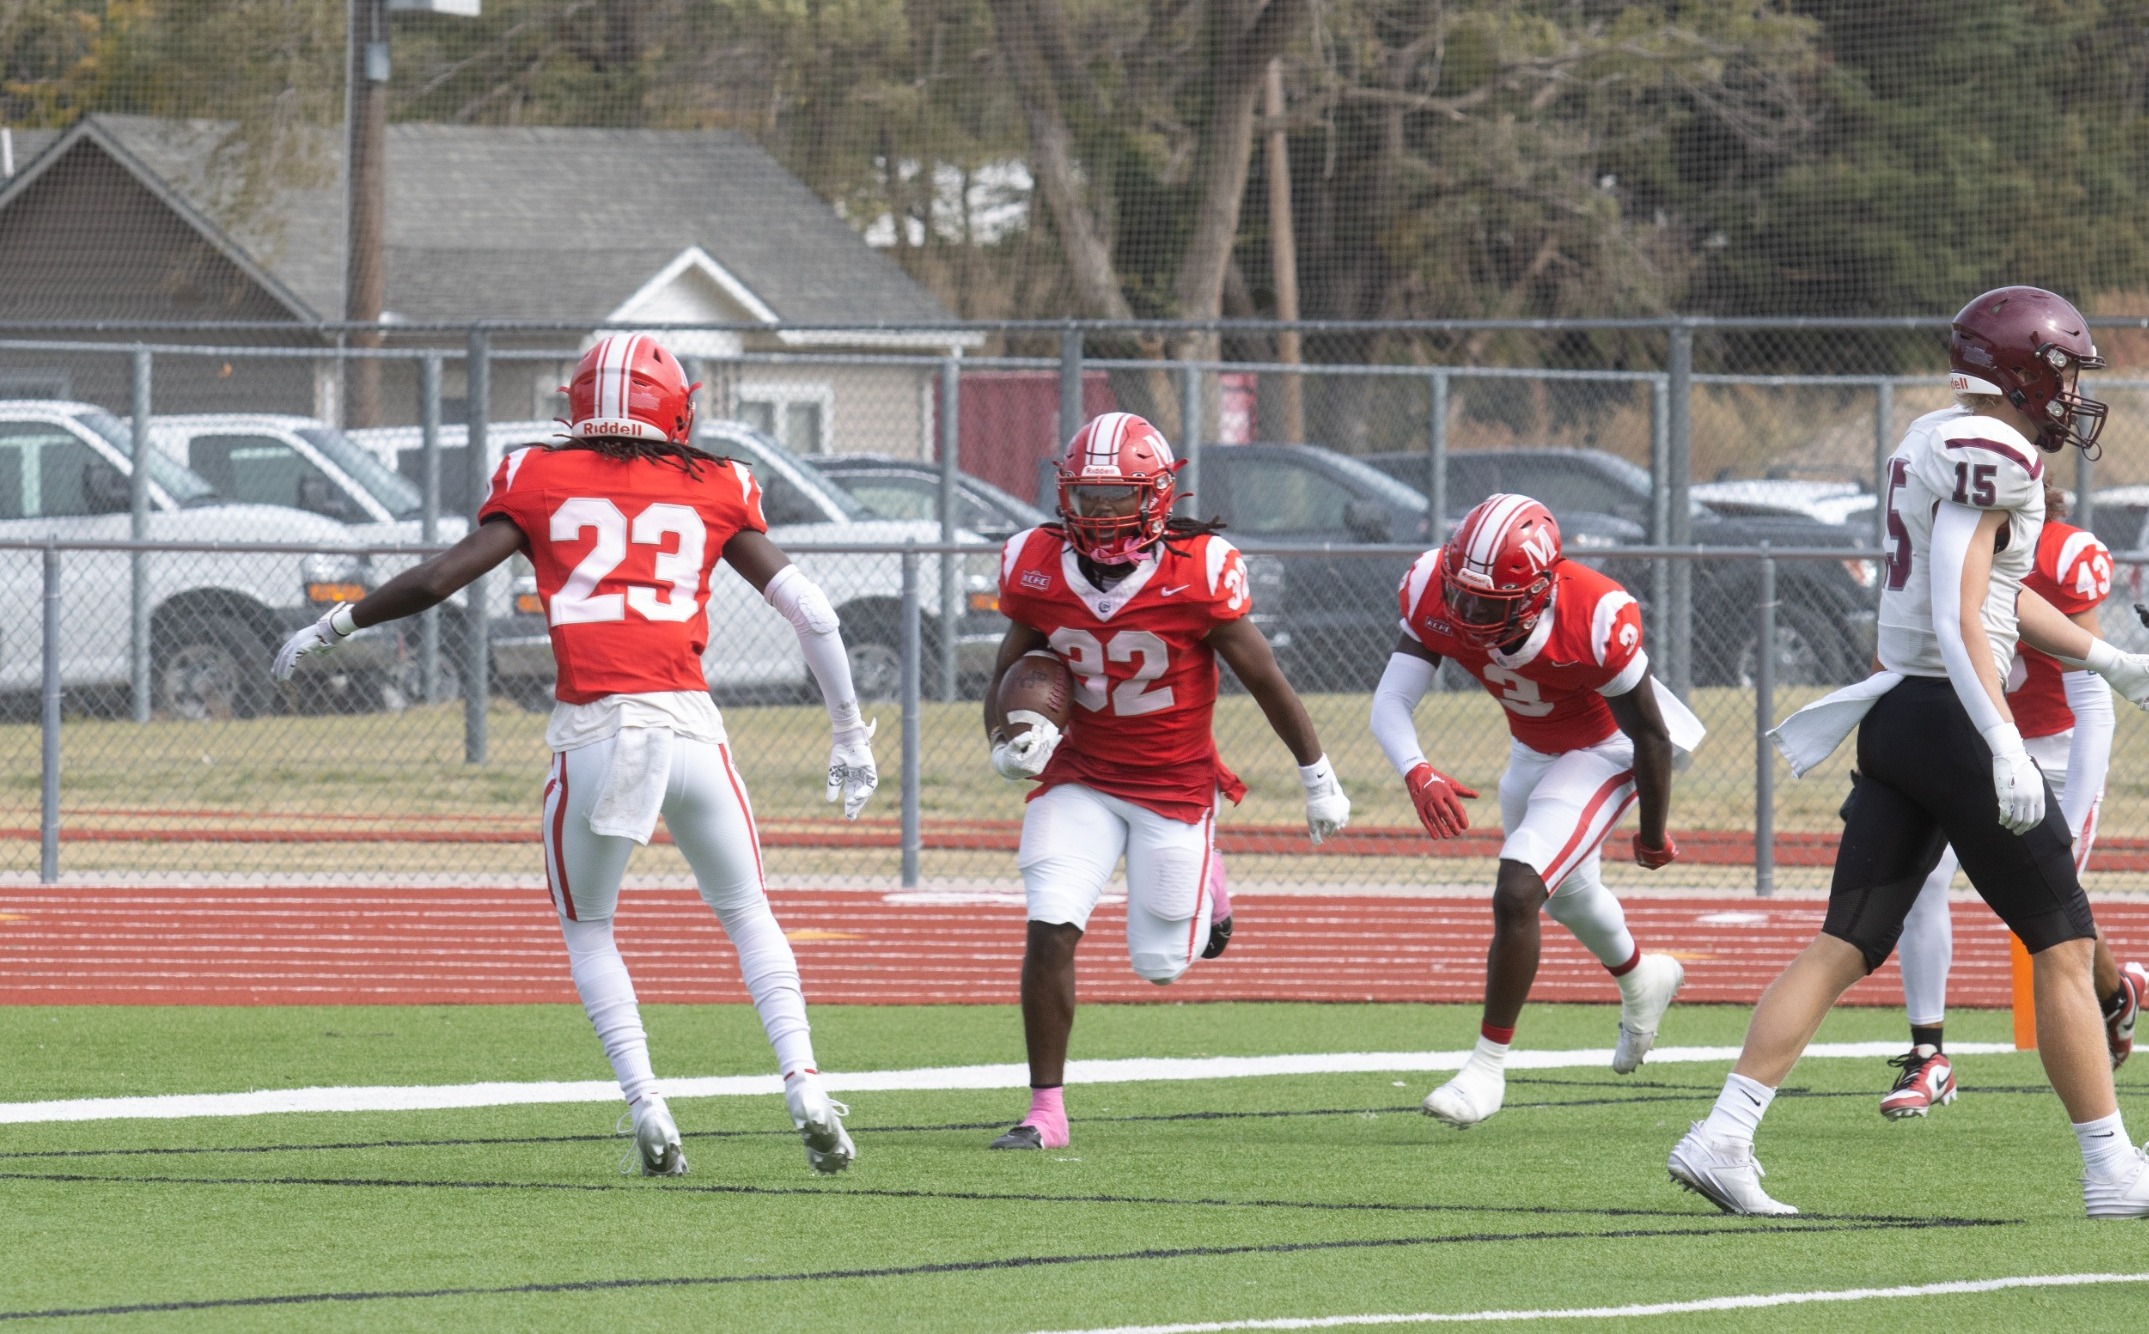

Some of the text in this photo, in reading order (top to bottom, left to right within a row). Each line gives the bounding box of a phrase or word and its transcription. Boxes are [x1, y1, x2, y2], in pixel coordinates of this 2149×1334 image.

[583, 421, 642, 436] Riddell
[1952, 461, 1998, 507] 15
[1520, 524, 1558, 576] M
[1883, 457, 1912, 592] 5
[550, 497, 707, 627] 23
[2075, 554, 2111, 601] 43
[1050, 626, 1175, 717] 32
[1482, 663, 1555, 717] 3
